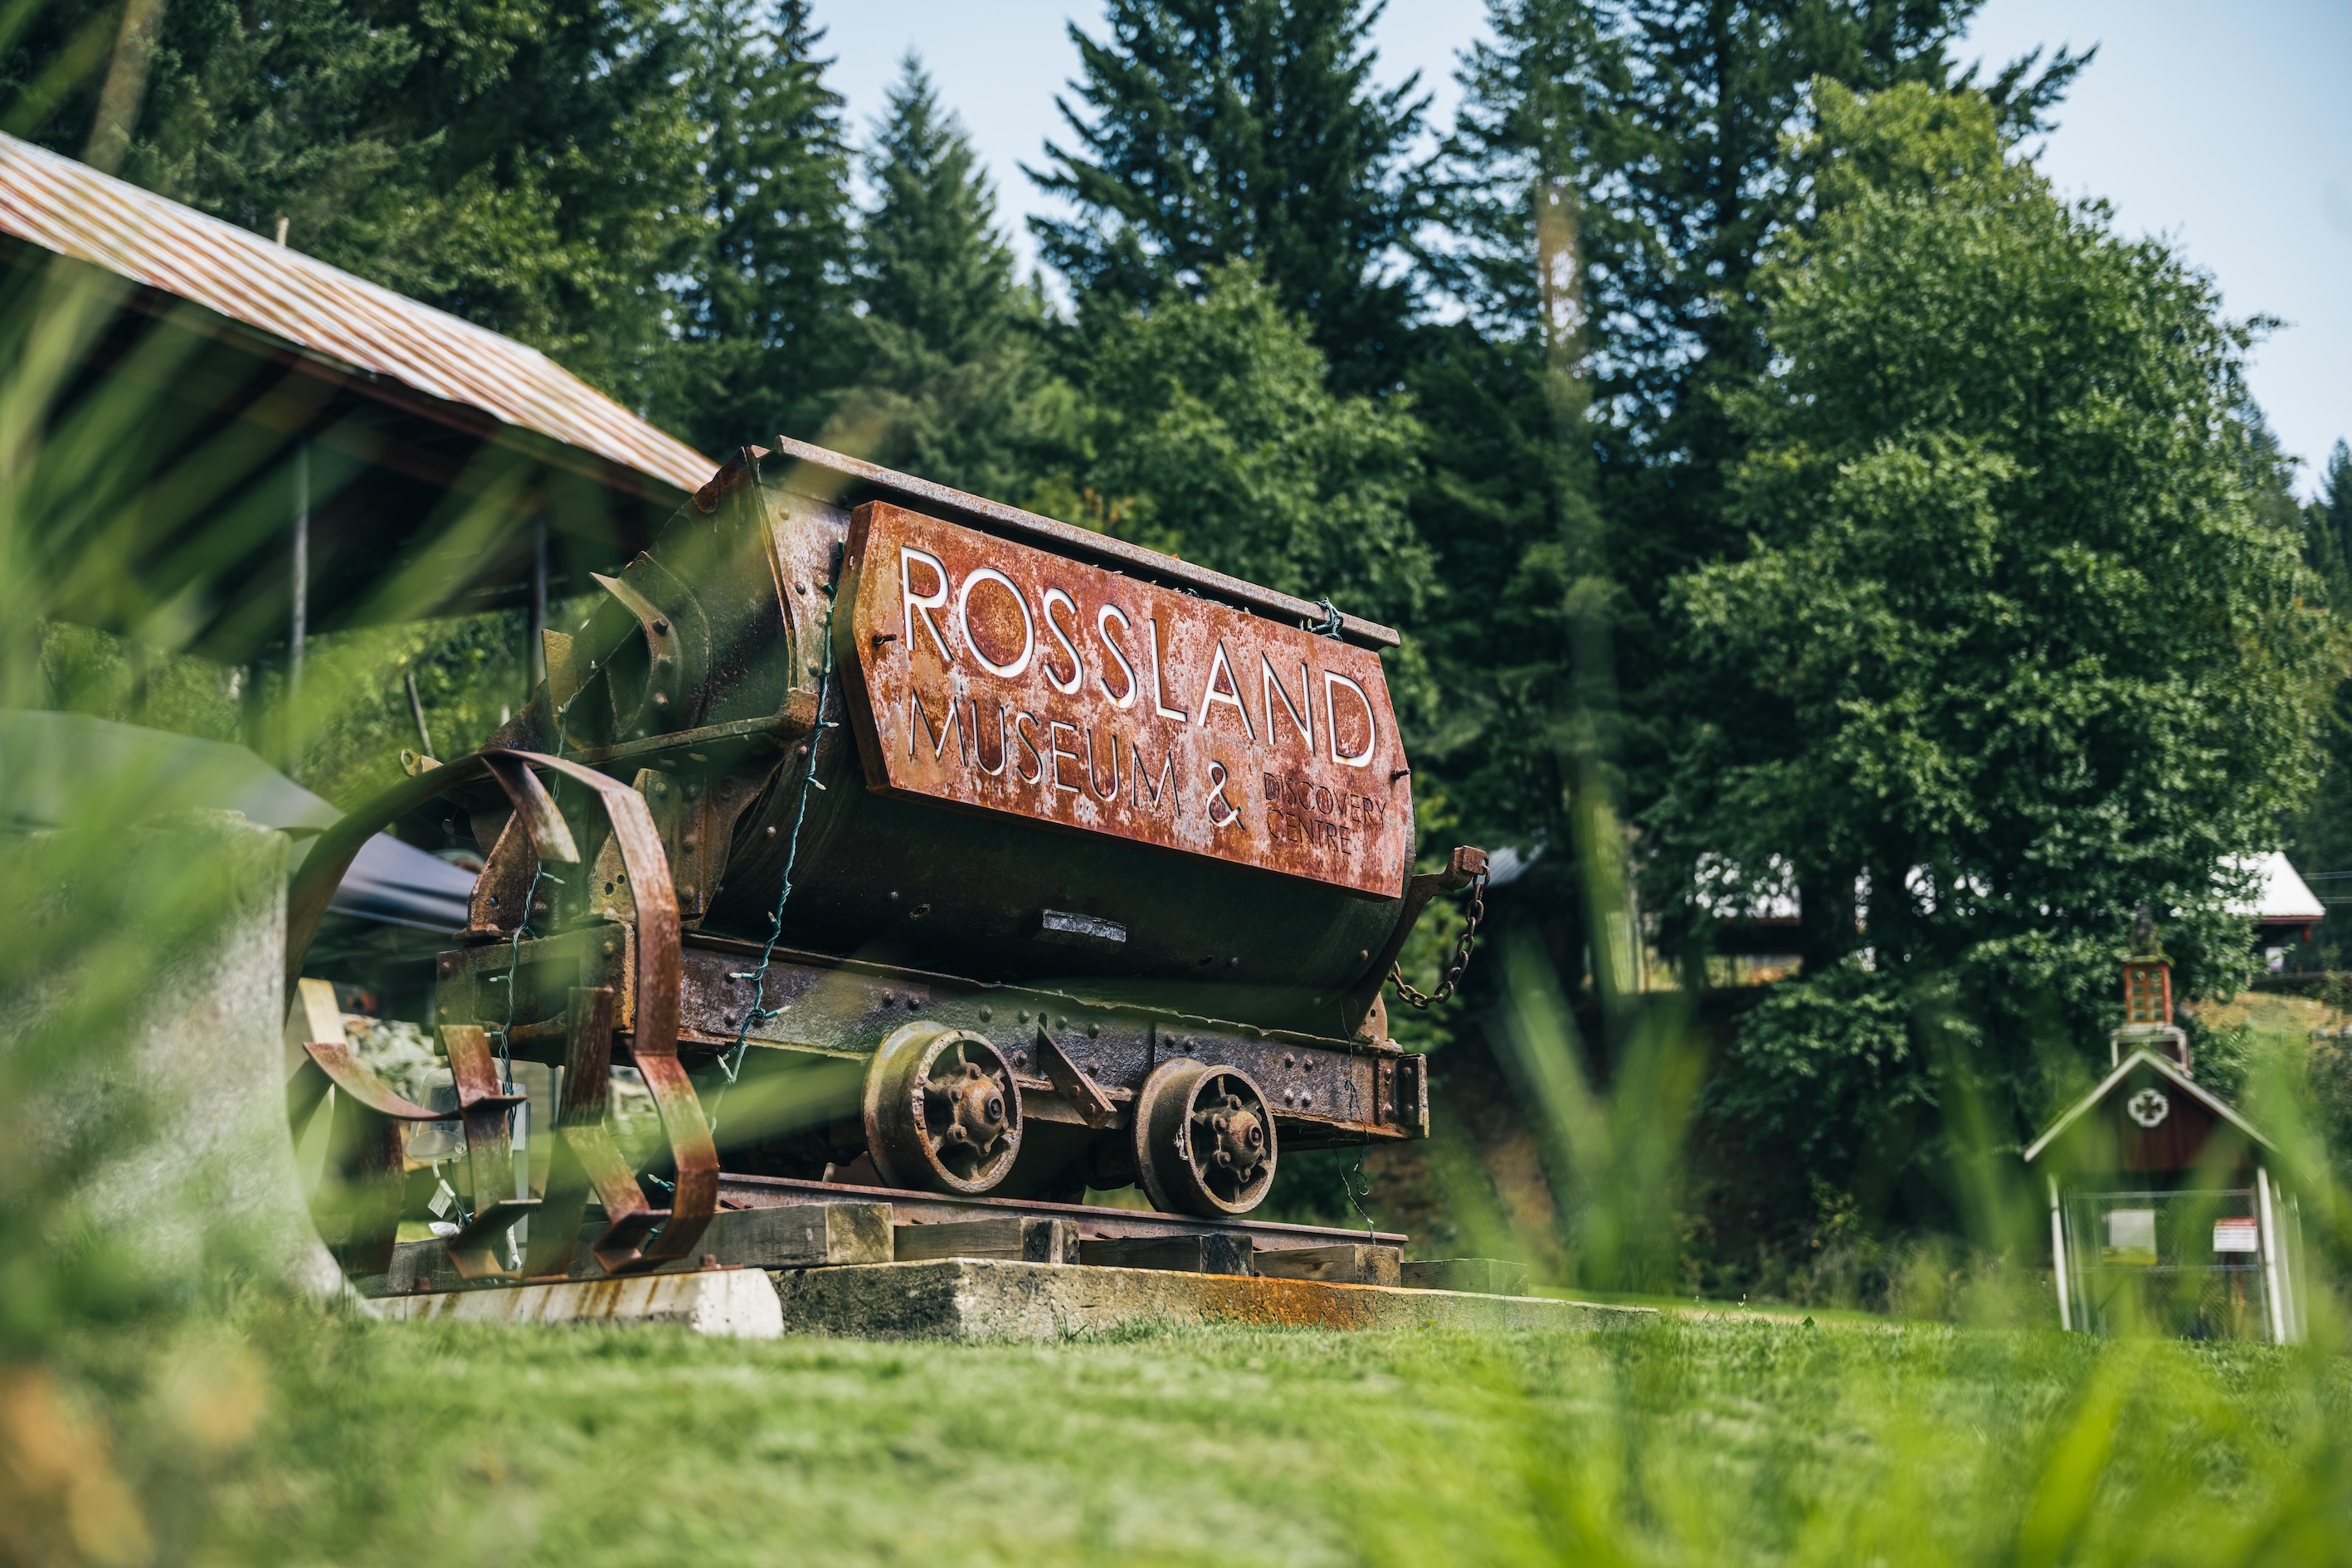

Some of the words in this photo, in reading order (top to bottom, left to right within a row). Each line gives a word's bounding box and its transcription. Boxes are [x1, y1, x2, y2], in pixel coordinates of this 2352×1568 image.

[900, 546, 1377, 767] ROSSLAND
[909, 687, 1181, 816] MUSEUM
[1205, 760, 1244, 830] &
[1264, 772, 1386, 828] DISCOVERY
[1267, 809, 1351, 855] CENTRE
